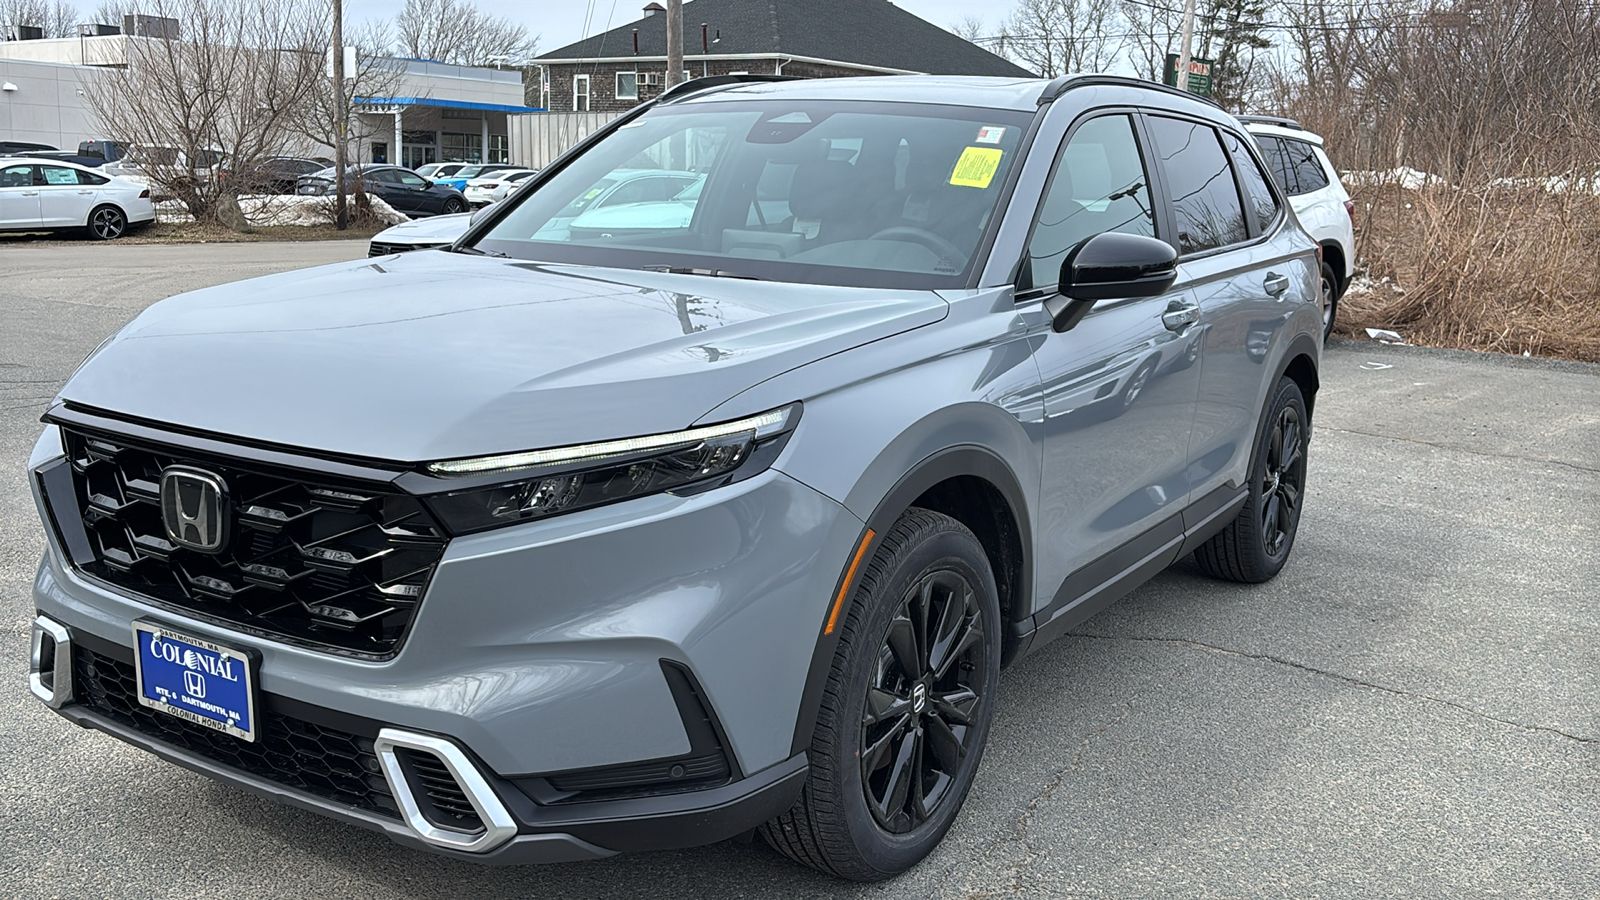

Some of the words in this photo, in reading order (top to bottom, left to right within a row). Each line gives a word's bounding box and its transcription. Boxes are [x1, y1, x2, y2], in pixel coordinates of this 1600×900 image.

[159, 629, 206, 648] DARTMOUTH,
[207, 643, 219, 652] MA
[150, 639, 238, 682] COLONIAL
[155, 686, 171, 698] RTE.
[171, 692, 178, 700] 6
[181, 694, 228, 718] DARTMOUTH,
[228, 709, 241, 721] MA
[167, 705, 200, 723] COLONIAL
[201, 717, 227, 732] HONDA
